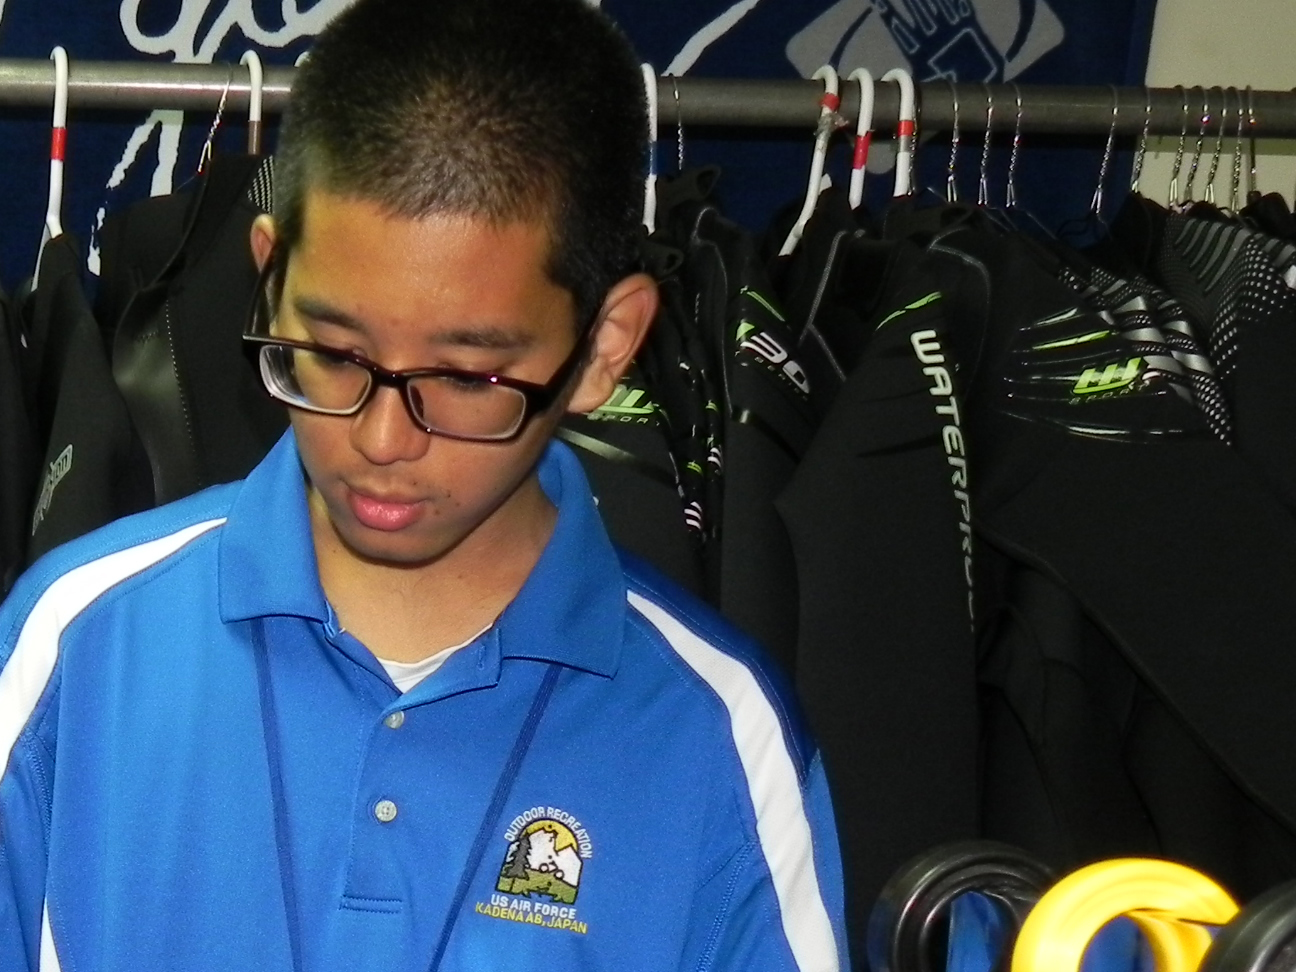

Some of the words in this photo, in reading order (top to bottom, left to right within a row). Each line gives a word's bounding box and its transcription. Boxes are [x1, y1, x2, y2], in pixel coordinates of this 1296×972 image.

[504, 806, 546, 842] OUTDOOR
[546, 806, 593, 859] RECREATION
[475, 901, 525, 923] KADENA
[547, 917, 588, 935] JAPAN
[490, 893, 509, 908] US
[510, 898, 532, 913] AIR
[533, 902, 577, 920] FORCE
